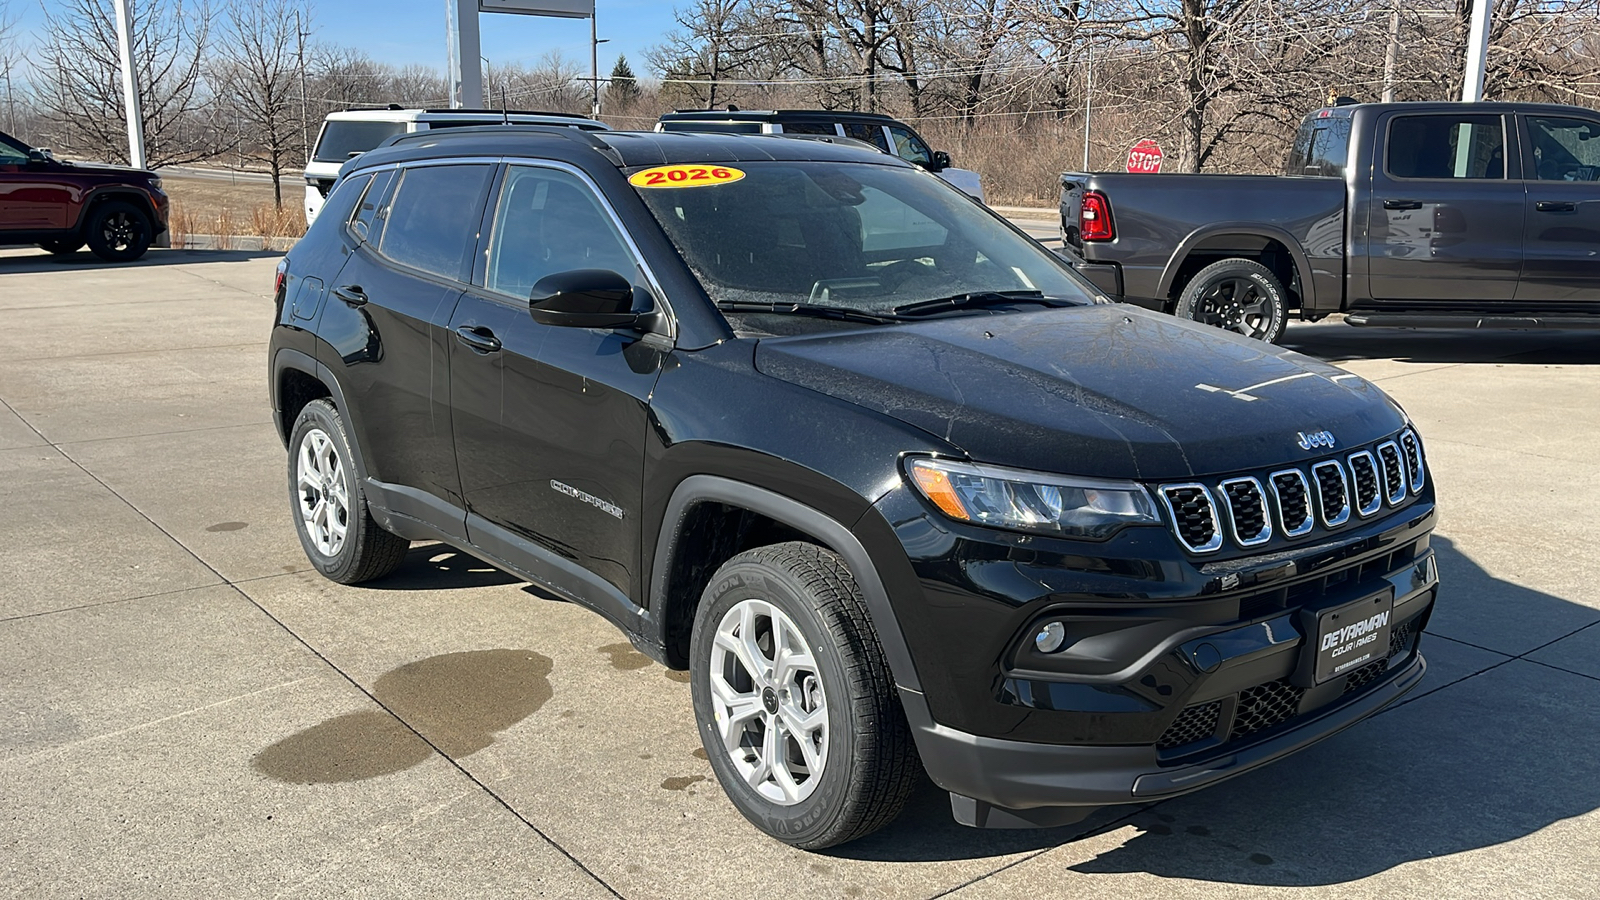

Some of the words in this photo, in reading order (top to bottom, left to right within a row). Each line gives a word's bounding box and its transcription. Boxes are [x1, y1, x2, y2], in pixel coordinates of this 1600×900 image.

[1129, 151, 1160, 171] STOP
[645, 168, 731, 185] 2026
[1297, 430, 1335, 450] Jeep
[550, 479, 623, 520] COMPASS
[1321, 610, 1390, 651] DEYARMAN
[1356, 632, 1378, 648] AMES
